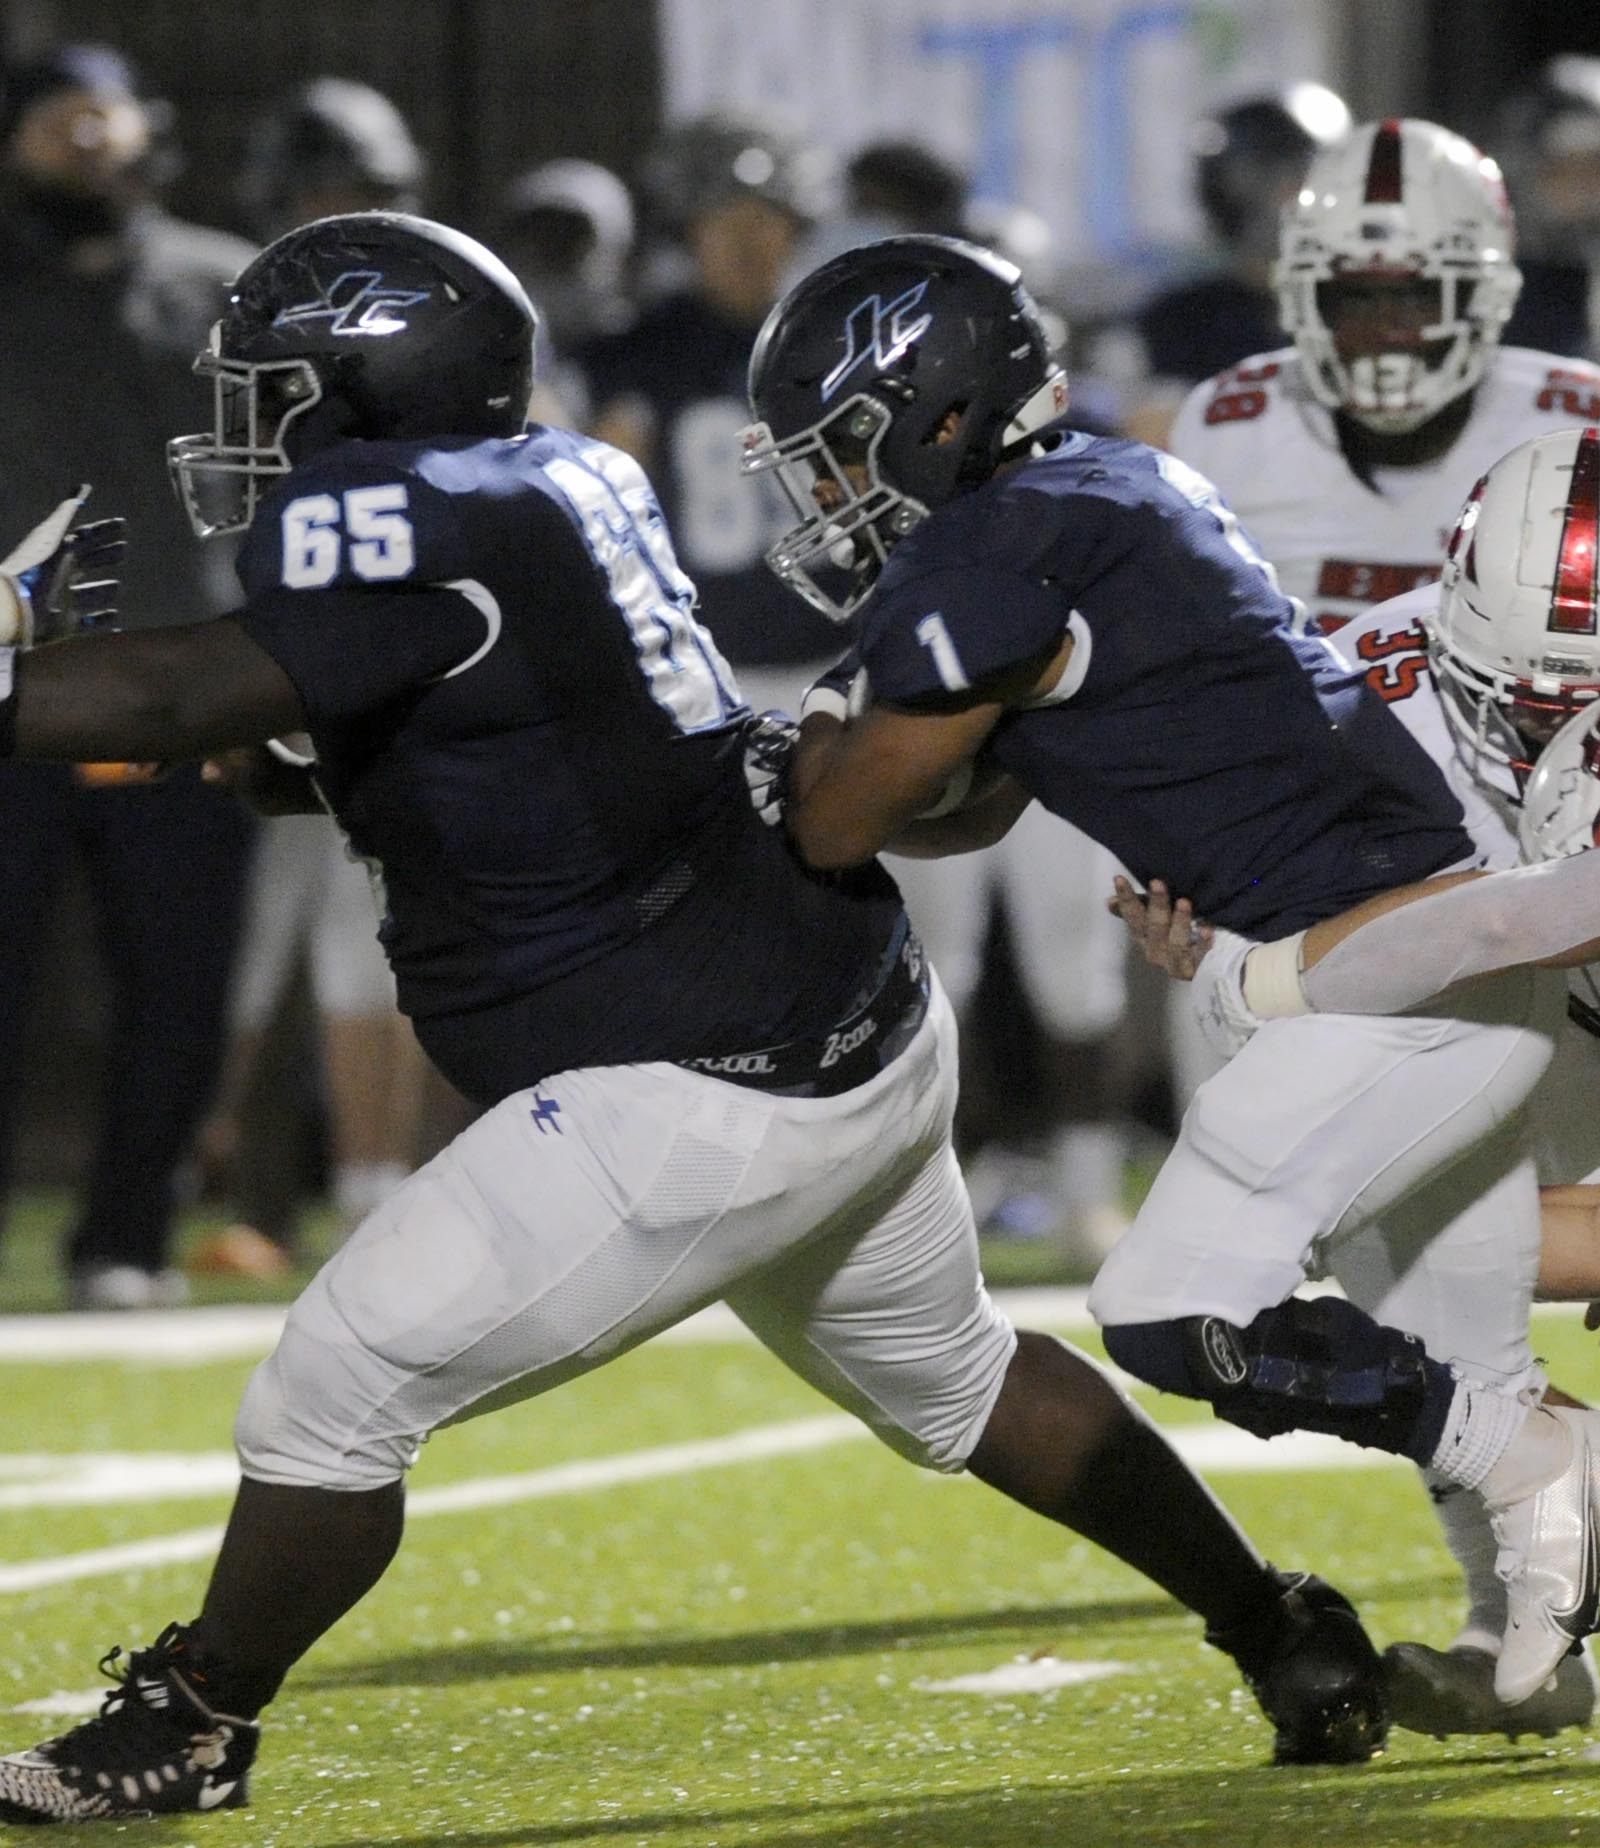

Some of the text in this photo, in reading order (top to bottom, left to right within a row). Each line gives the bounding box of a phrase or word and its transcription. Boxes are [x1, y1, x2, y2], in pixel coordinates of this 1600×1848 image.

[281, 483, 415, 590] 65
[915, 611, 971, 692] 1
[1356, 617, 1430, 704] 35
[679, 1054, 778, 1074] -COOL
